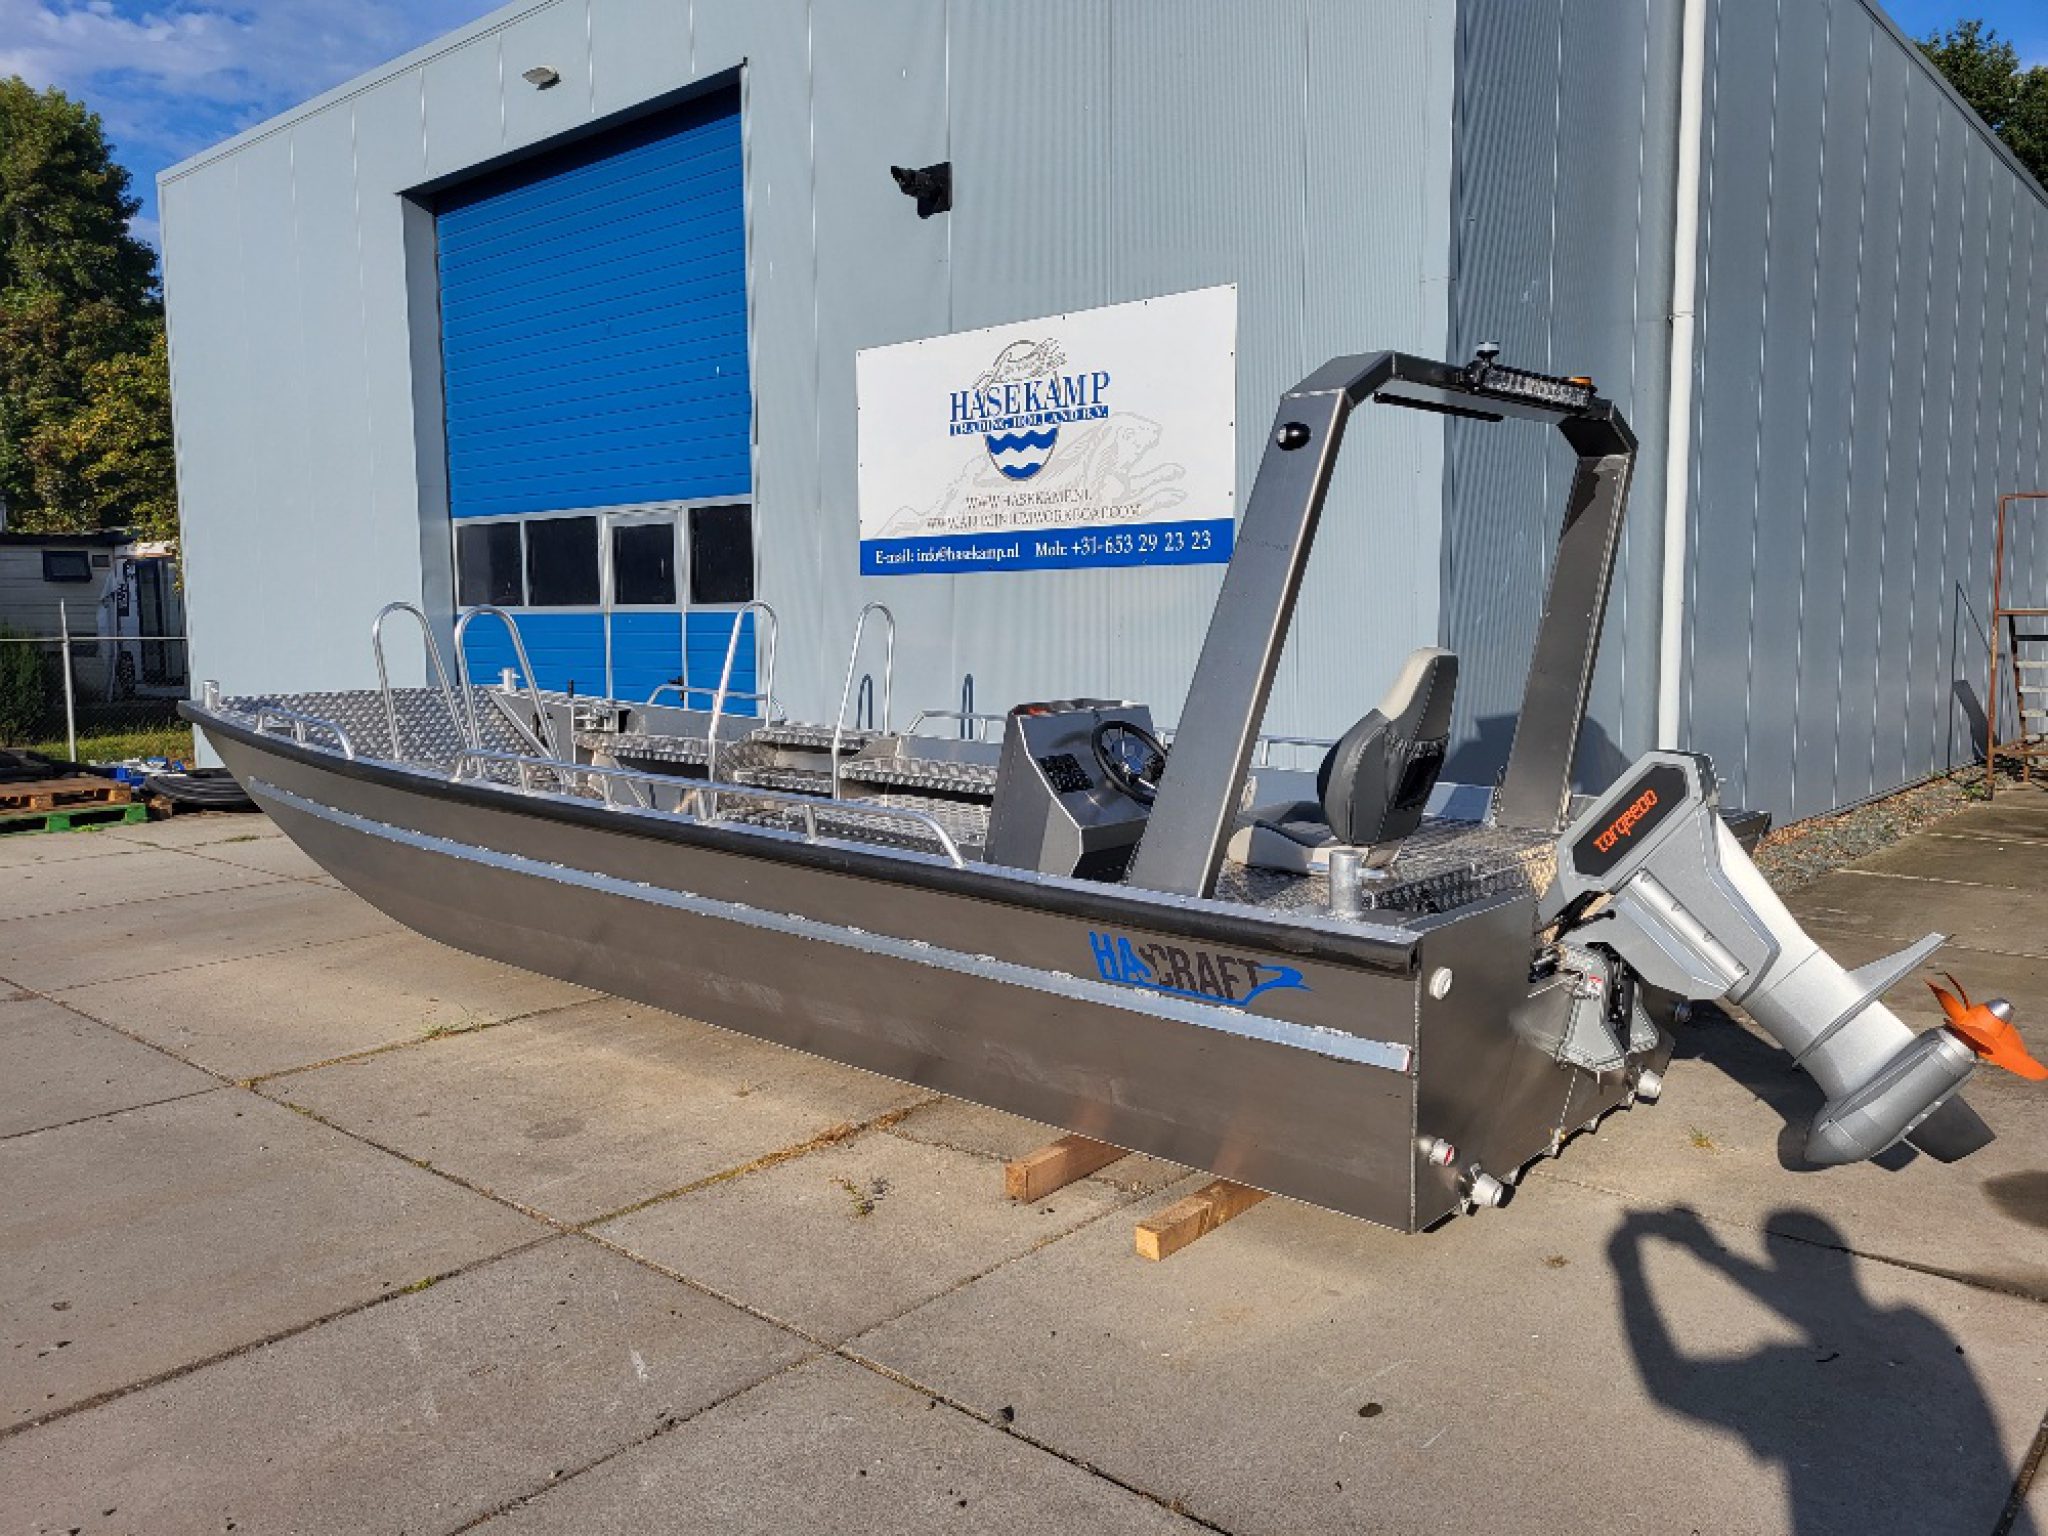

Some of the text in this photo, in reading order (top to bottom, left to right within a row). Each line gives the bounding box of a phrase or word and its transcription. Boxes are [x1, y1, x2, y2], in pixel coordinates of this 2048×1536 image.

[949, 370, 1110, 422] HASEKAMP
[875, 548, 914, 564] E-mail:
[916, 542, 1020, 562] info@hasekamp.nl
[1071, 534, 1133, 556] +31-653
[1138, 533, 1158, 552] 29
[1164, 531, 1185, 552] 23
[1191, 529, 1212, 550] 23
